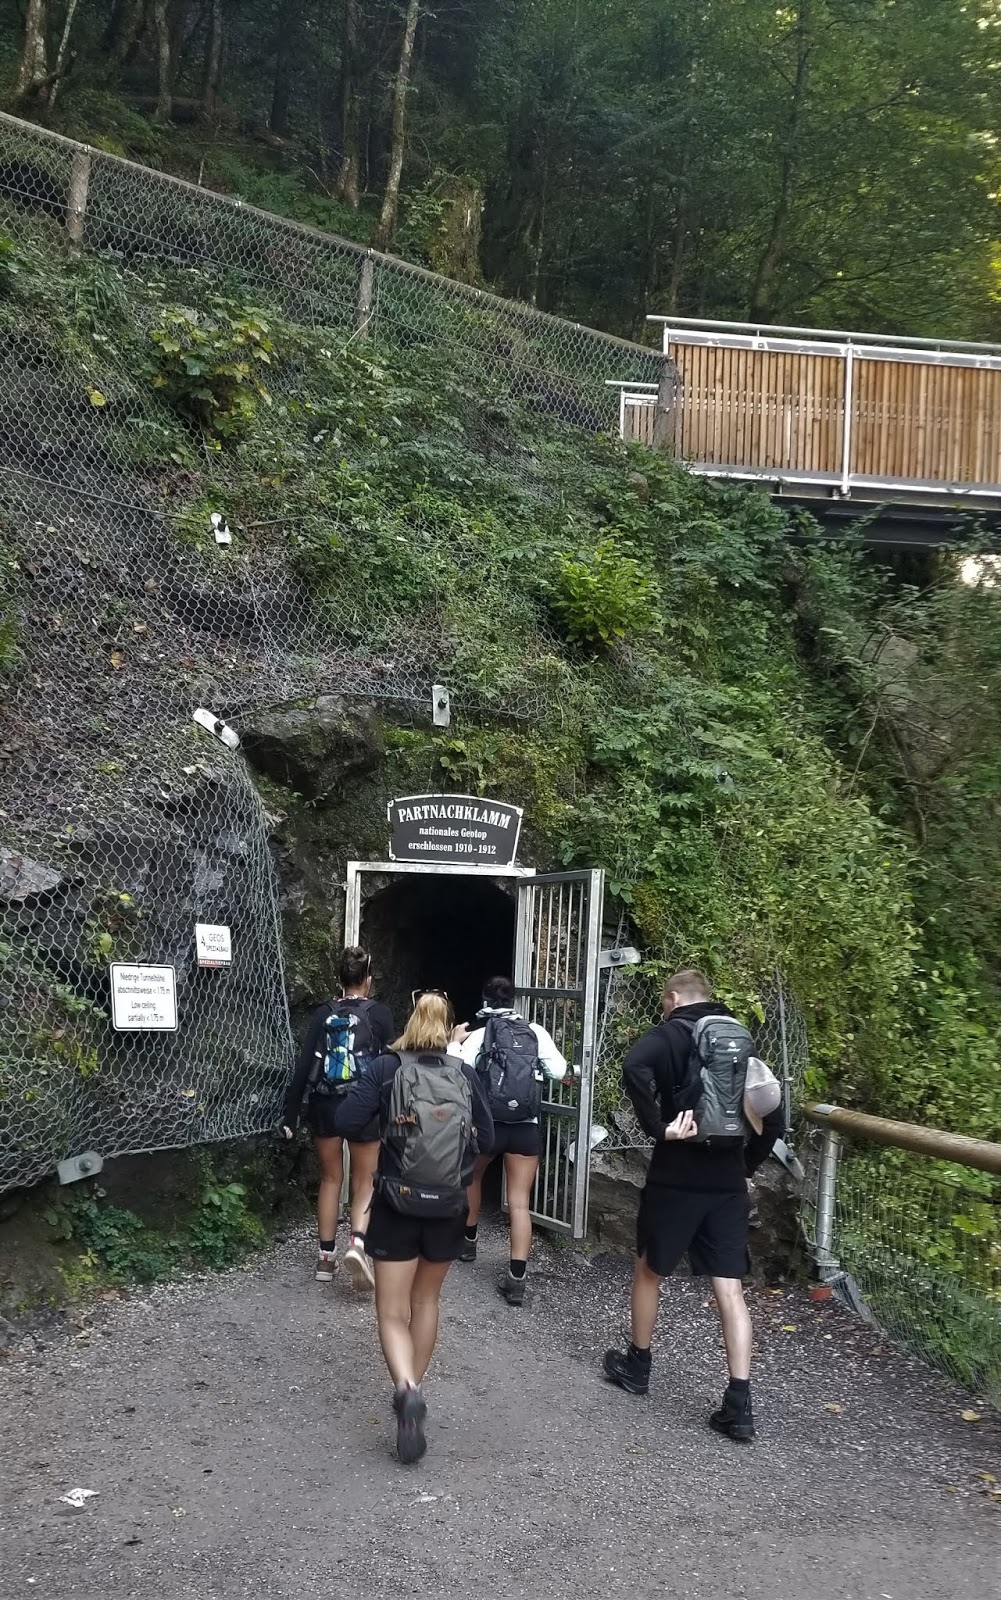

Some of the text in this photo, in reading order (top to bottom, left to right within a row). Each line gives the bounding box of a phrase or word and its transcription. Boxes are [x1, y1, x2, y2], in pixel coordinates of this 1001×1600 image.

[398, 804, 511, 829] PARTNACHKLAMM
[419, 826, 487, 840] nationales Geotop
[408, 841, 453, 852] erschlossen
[208, 932, 225, 943] GEOS
[131, 1001, 156, 1011] Low ceiling
[128, 1014, 146, 1023] partially
